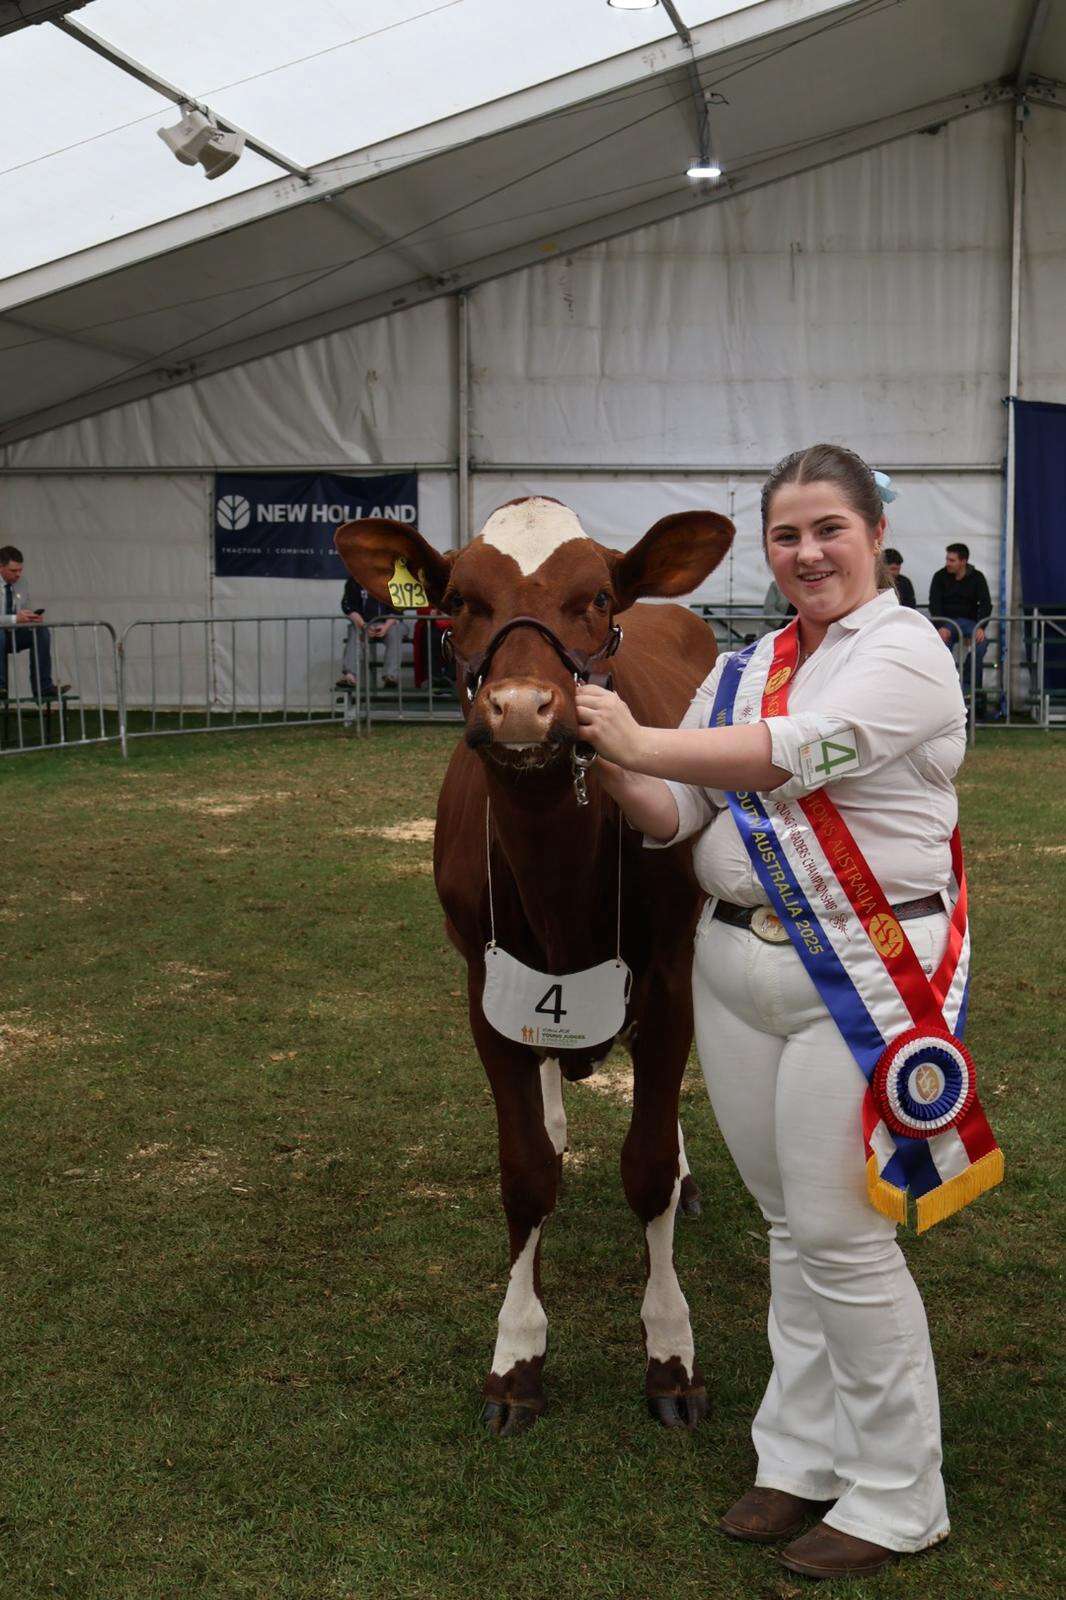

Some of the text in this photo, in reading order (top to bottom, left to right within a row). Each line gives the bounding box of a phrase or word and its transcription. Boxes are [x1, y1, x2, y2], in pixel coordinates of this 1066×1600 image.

[257, 504, 416, 523] NEW HOLLAND
[275, 548, 315, 556] COMBINES
[389, 582, 427, 607] 3193
[815, 741, 857, 776] 4
[736, 791, 825, 955] OUTH AUSTRALIA 2025
[806, 795, 878, 914] HOWS AUSTRALIA
[801, 857, 839, 911] CHAMPIONSHIP
[534, 983, 568, 1024] 4
